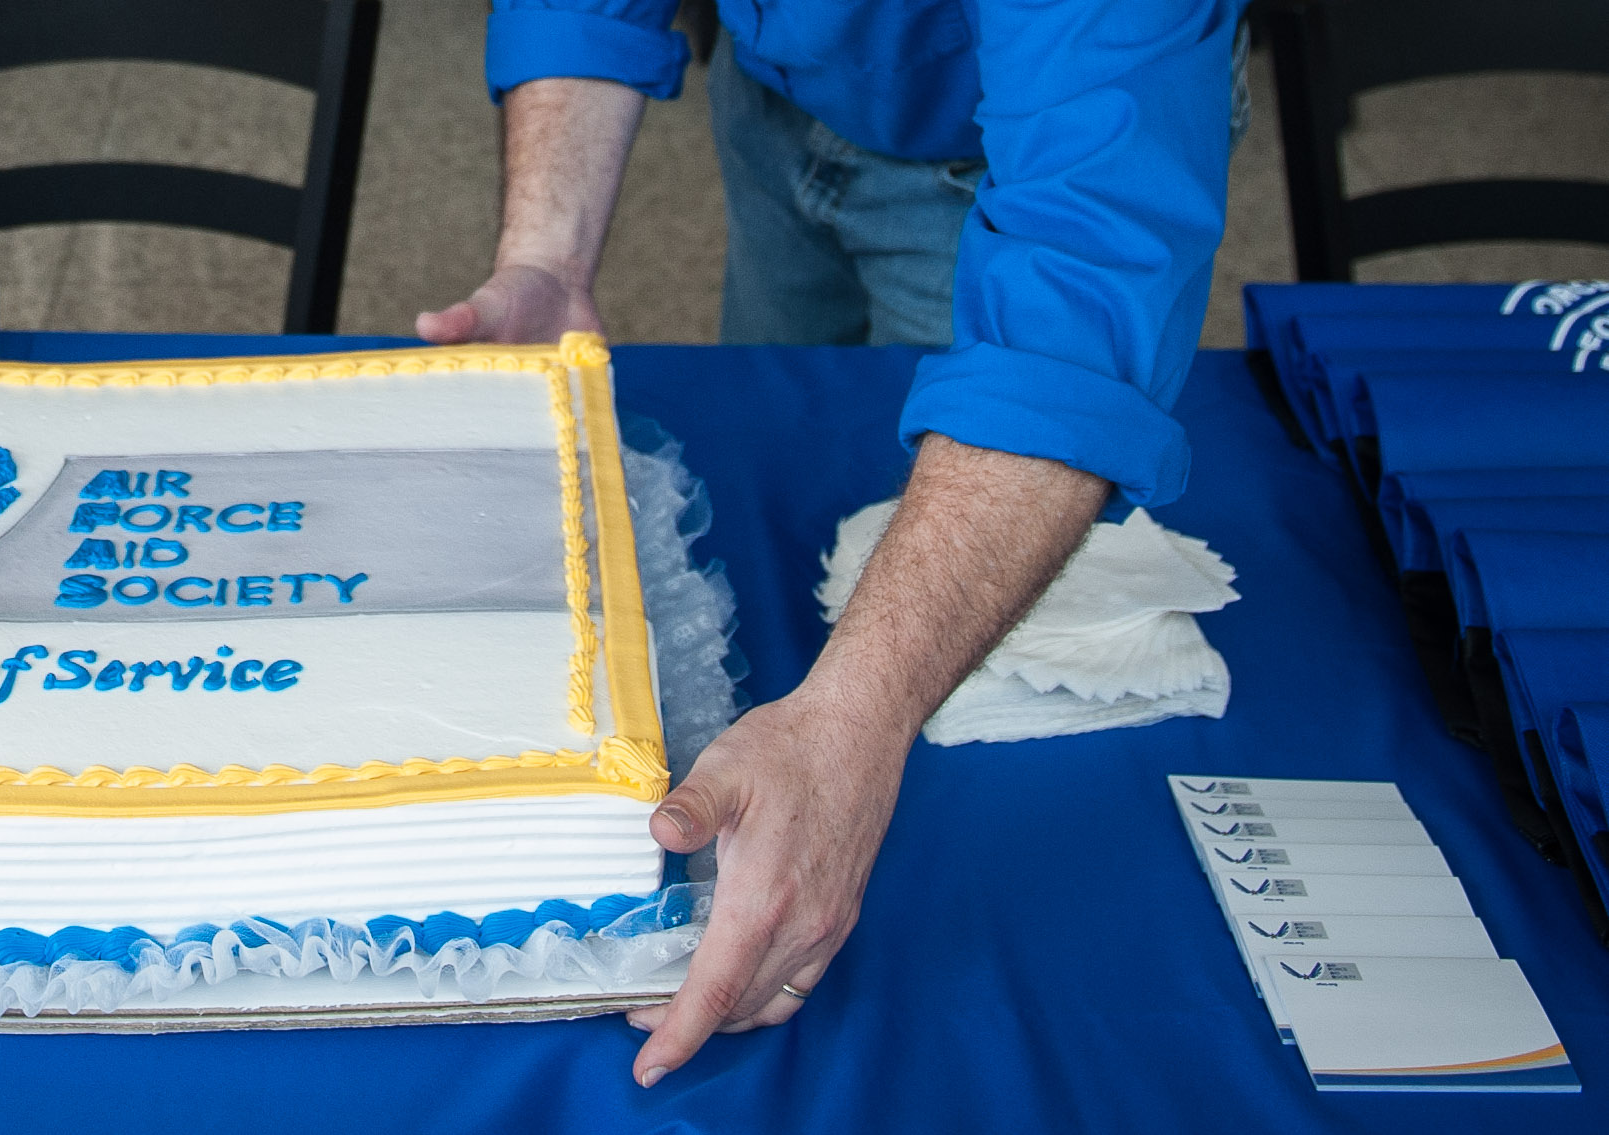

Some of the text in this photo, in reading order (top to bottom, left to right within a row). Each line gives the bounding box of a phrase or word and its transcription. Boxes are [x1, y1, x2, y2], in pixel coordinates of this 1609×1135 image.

[79, 469, 191, 500] AIR
[68, 501, 305, 533] FORCE
[63, 537, 189, 570] AID
[54, 572, 369, 608] SOCIETY
[43, 645, 303, 692] Service
